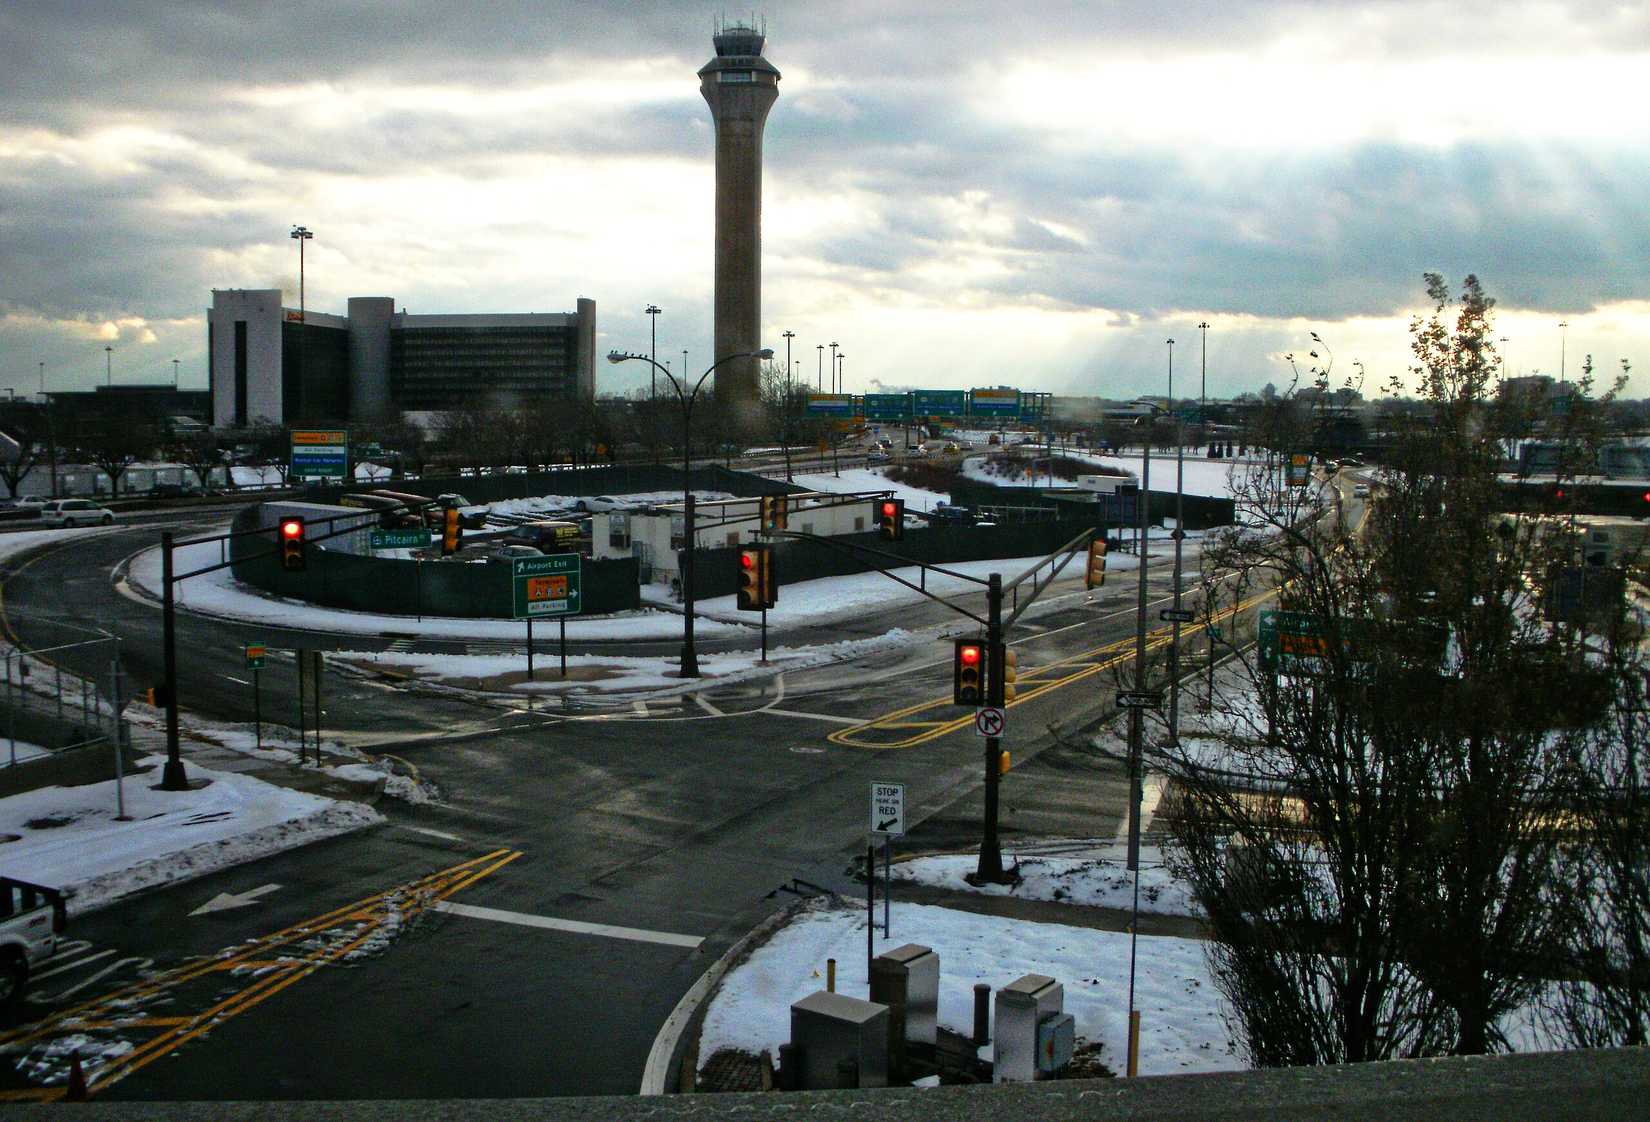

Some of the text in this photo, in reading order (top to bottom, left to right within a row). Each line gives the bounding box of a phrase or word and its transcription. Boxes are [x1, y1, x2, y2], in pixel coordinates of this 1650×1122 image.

[385, 535, 418, 545] Pitcairn
[527, 560, 567, 570] Airport Exit
[877, 787, 898, 796] STOP
[878, 807, 896, 815] RED
